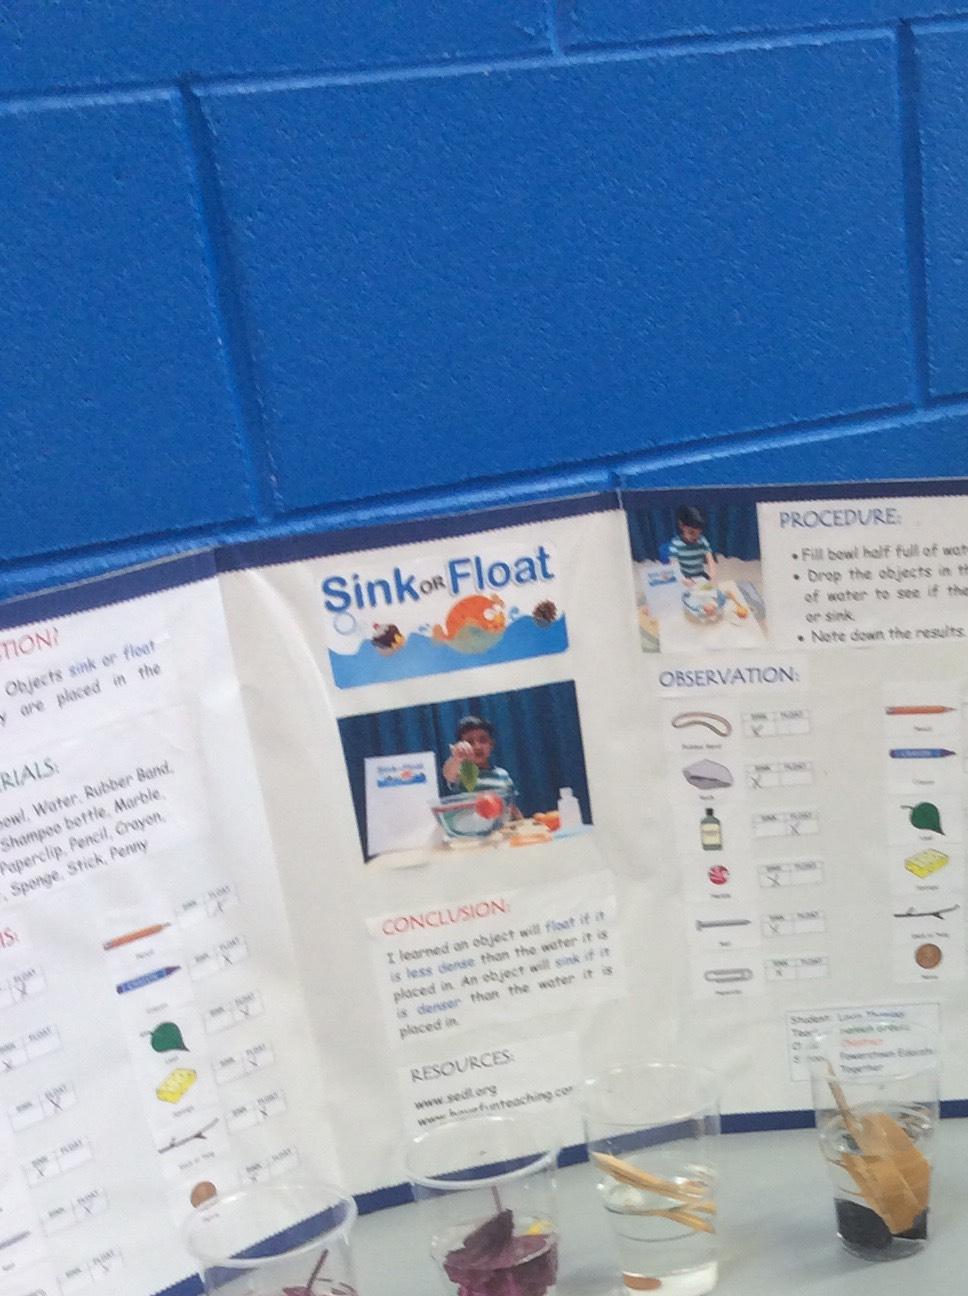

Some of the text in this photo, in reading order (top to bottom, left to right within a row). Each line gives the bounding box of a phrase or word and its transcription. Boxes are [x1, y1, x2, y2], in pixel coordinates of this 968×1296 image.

[779, 507, 902, 529] PROCEDURE:
[801, 547, 823, 561] Fill
[827, 545, 859, 560] bowl
[862, 544, 891, 559] half
[896, 543, 919, 558] full
[922, 543, 938, 557] of
[321, 546, 556, 613] Sink OR Float
[807, 568, 842, 585] Drop
[849, 566, 872, 581] the
[878, 564, 932, 583] objects
[938, 565, 951, 577] in
[804, 589, 820, 603] of
[827, 588, 868, 602] water
[875, 587, 890, 601] to
[897, 589, 920, 600] see
[805, 612, 821, 624] or
[811, 629, 849, 644] Note
[850, 627, 884, 642] down
[888, 625, 910, 640] the
[5, 639, 156, 698] Objects sink or float
[659, 665, 801, 689] OBSERVATION:
[20, 699, 45, 718] are
[57, 679, 102, 709] placed
[113, 671, 127, 688] in
[138, 662, 161, 681] the
[84, 774, 134, 800] Rubber
[0, 822, 62, 852] Shampoo
[110, 839, 148, 861] Penny
[381, 898, 511, 937] CONCLUSION:
[387, 951, 396, 965] I
[399, 941, 450, 962] learned
[453, 939, 470, 953] an
[472, 929, 515, 949] object
[519, 922, 541, 938] will
[545, 916, 575, 933] float
[391, 971, 402, 984] is
[406, 965, 434, 980] less
[438, 957, 477, 975] dense
[480, 950, 510, 966] than
[515, 945, 537, 959] the
[541, 937, 578, 953] water
[597, 928, 609, 941] is
[393, 982, 437, 1005] placed
[460, 974, 479, 988] An
[482, 965, 525, 985] object
[529, 957, 551, 974] will
[554, 953, 581, 969] sink
[396, 1006, 408, 1020] is
[416, 996, 462, 1016] denser
[470, 989, 500, 1004] than
[508, 982, 530, 997] the
[538, 974, 577, 991] water
[601, 964, 613, 977] is
[399, 1017, 442, 1041] placed
[410, 1048, 516, 1084] RESOURCES:
